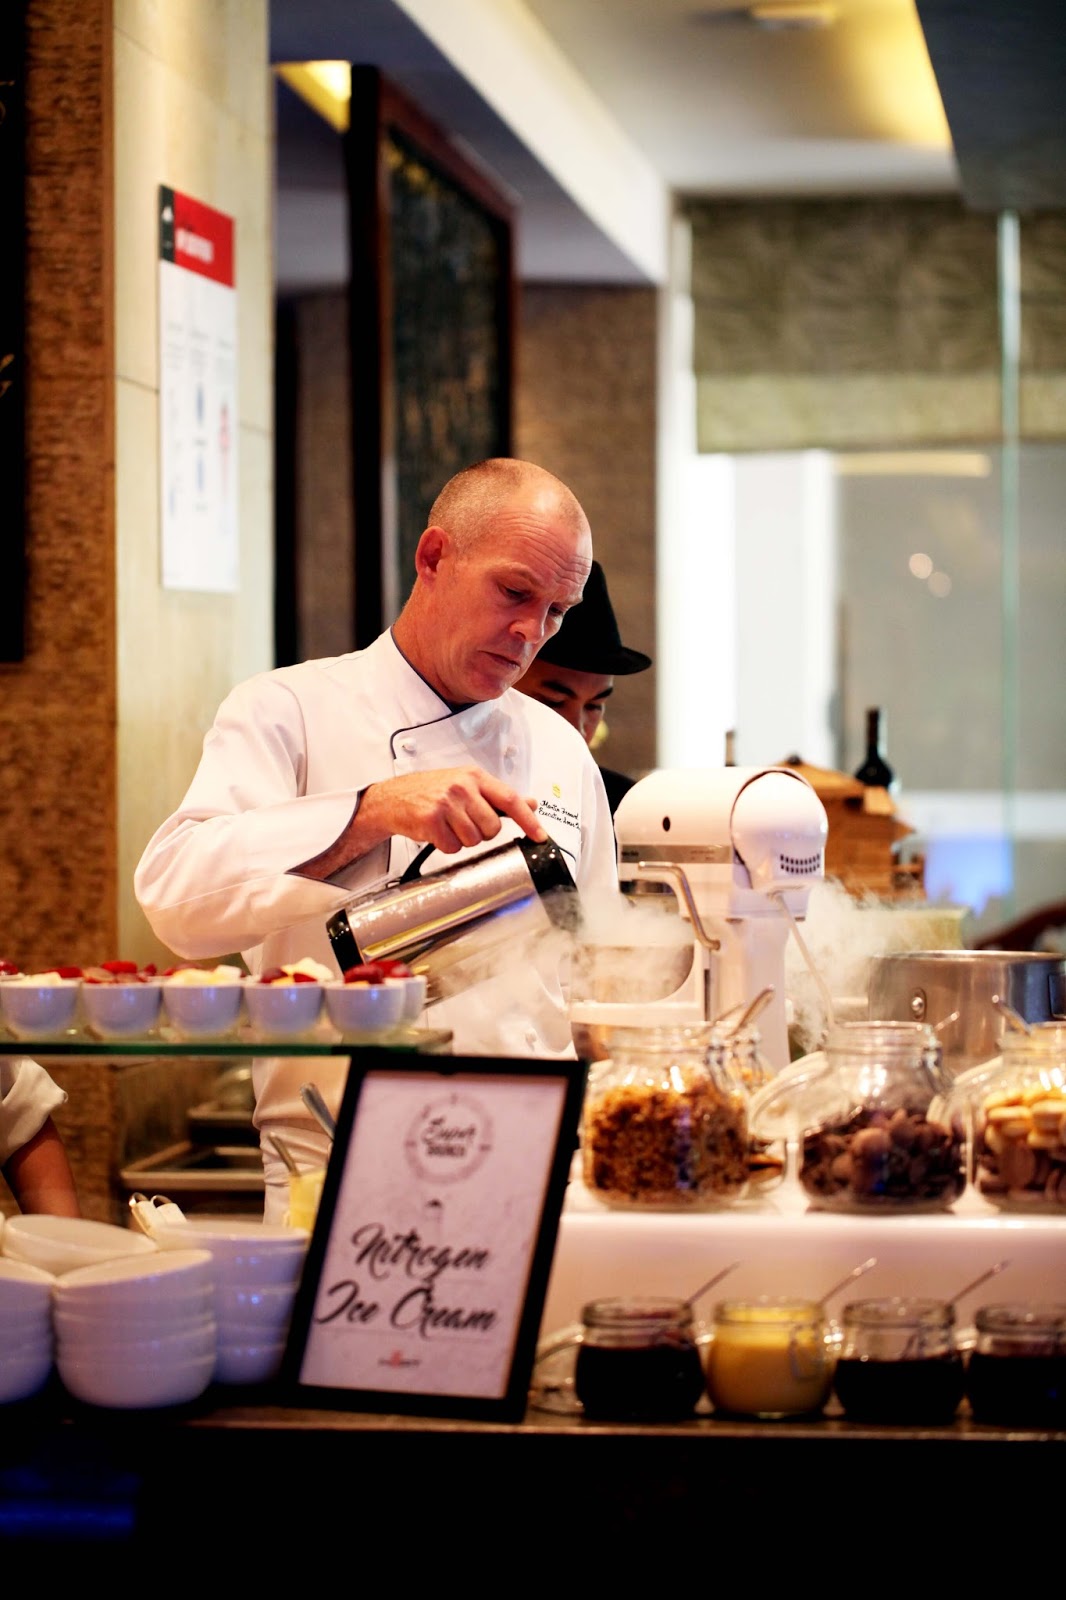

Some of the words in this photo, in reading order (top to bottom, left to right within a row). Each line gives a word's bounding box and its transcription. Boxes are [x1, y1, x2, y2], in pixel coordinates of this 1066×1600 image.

[351, 1222, 489, 1282] Nitrogen
[314, 1279, 379, 1324] Ice
[389, 1284, 497, 1339] Cream
